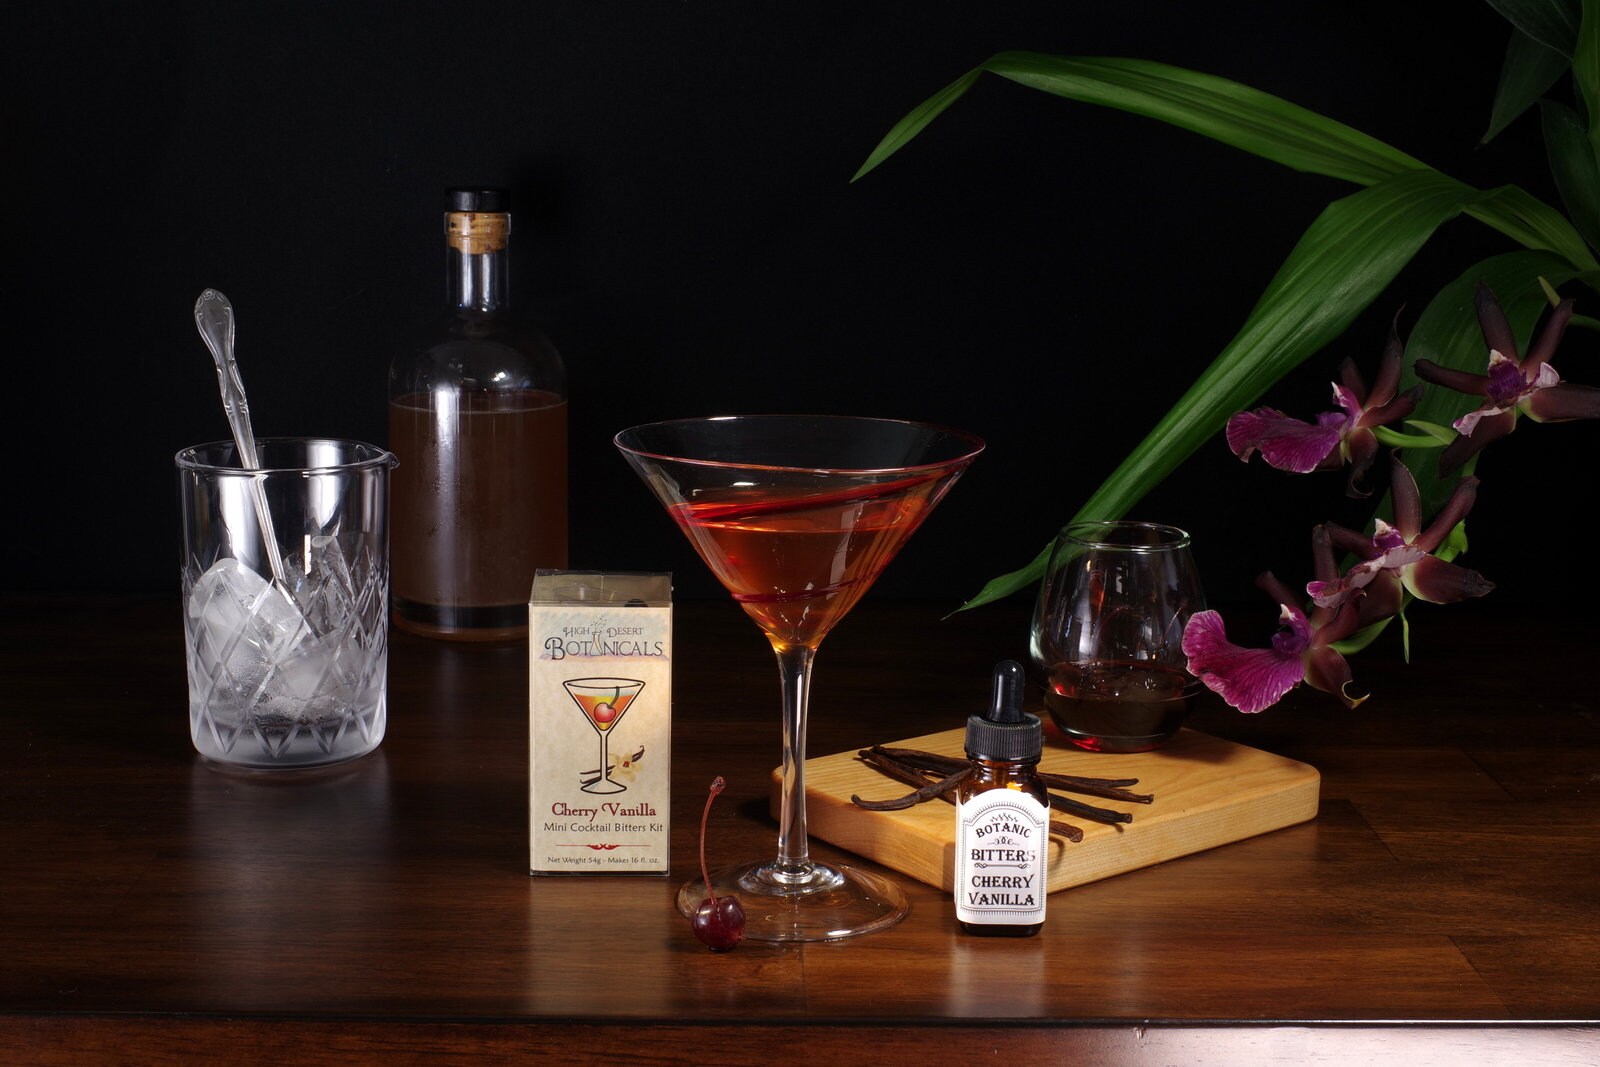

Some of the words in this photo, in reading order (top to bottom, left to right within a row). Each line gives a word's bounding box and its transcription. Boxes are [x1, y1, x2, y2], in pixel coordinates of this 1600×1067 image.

[562, 627, 590, 638] HIGH
[606, 627, 644, 638] DESERT
[551, 802, 598, 823] Cherry
[601, 802, 656, 817] Vanilla
[543, 822, 567, 832] Mini
[570, 822, 611, 832] Cocktail
[614, 823, 646, 832] Bitters
[649, 823, 663, 832] Kit
[975, 822, 1032, 839] BOTANIC
[562, 857, 586, 865] Weight
[588, 857, 601, 865] 54g
[971, 849, 1036, 862] BITTERS
[971, 874, 1035, 889] CHERRY
[968, 892, 1035, 906] VANILLA
